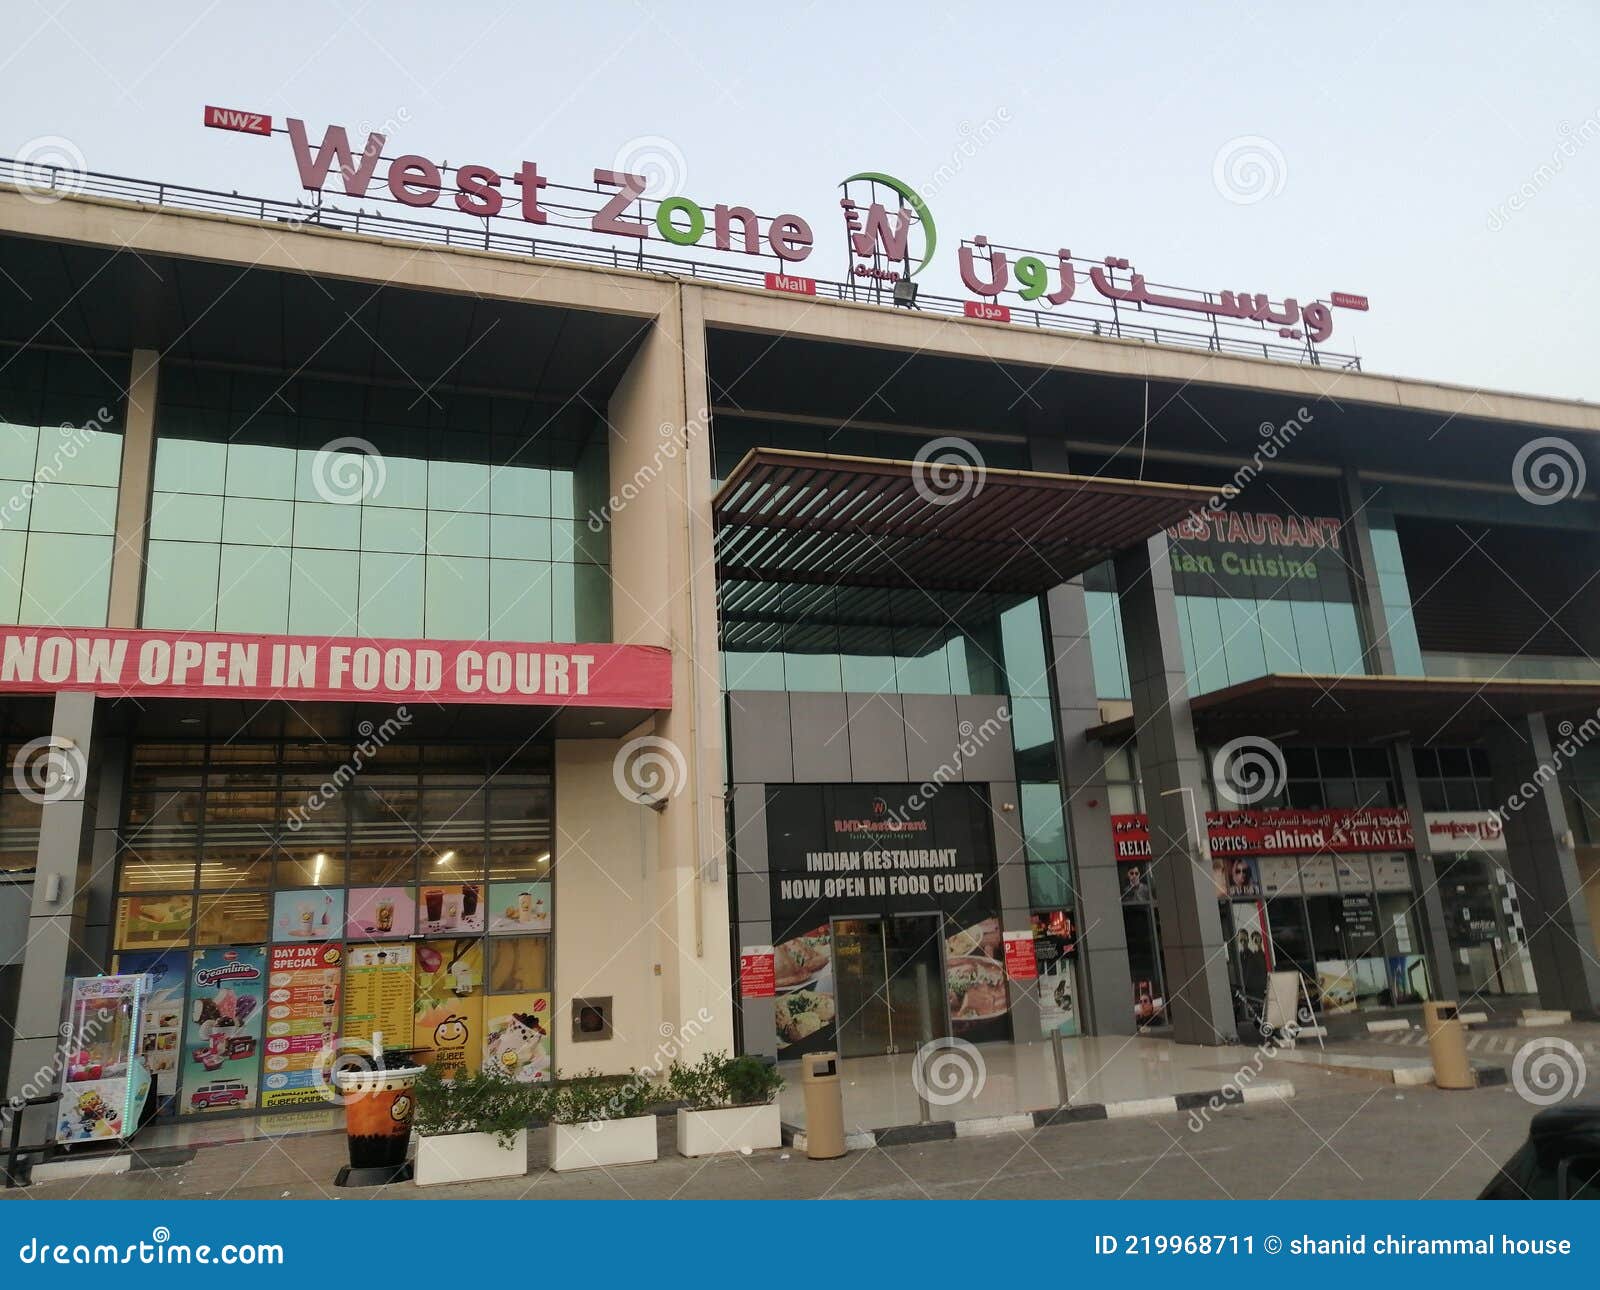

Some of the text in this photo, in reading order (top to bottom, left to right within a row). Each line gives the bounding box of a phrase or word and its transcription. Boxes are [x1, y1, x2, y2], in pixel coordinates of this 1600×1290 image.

[213, 109, 264, 131] NWZ
[286, 117, 815, 262] West Zone
[774, 276, 808, 293] Mall
[959, 234, 1334, 343] ويست زون
[972, 302, 1004, 321] مول
[1221, 551, 1318, 580] Cuisine
[1, 635, 595, 696] NOW OPEN IN FOOD COURT
[1211, 835, 1248, 851] OPTICS
[1264, 829, 1325, 849] alhind
[1350, 829, 1415, 847] TRAVELS
[806, 849, 957, 872] INDIAN RESTAURANT
[781, 873, 984, 900] NOW OPEN IN FOOD COURT
[273, 958, 319, 969] SPECIAL
[274, 947, 319, 958] DAY DAY
[197, 962, 251, 984] Creamline
